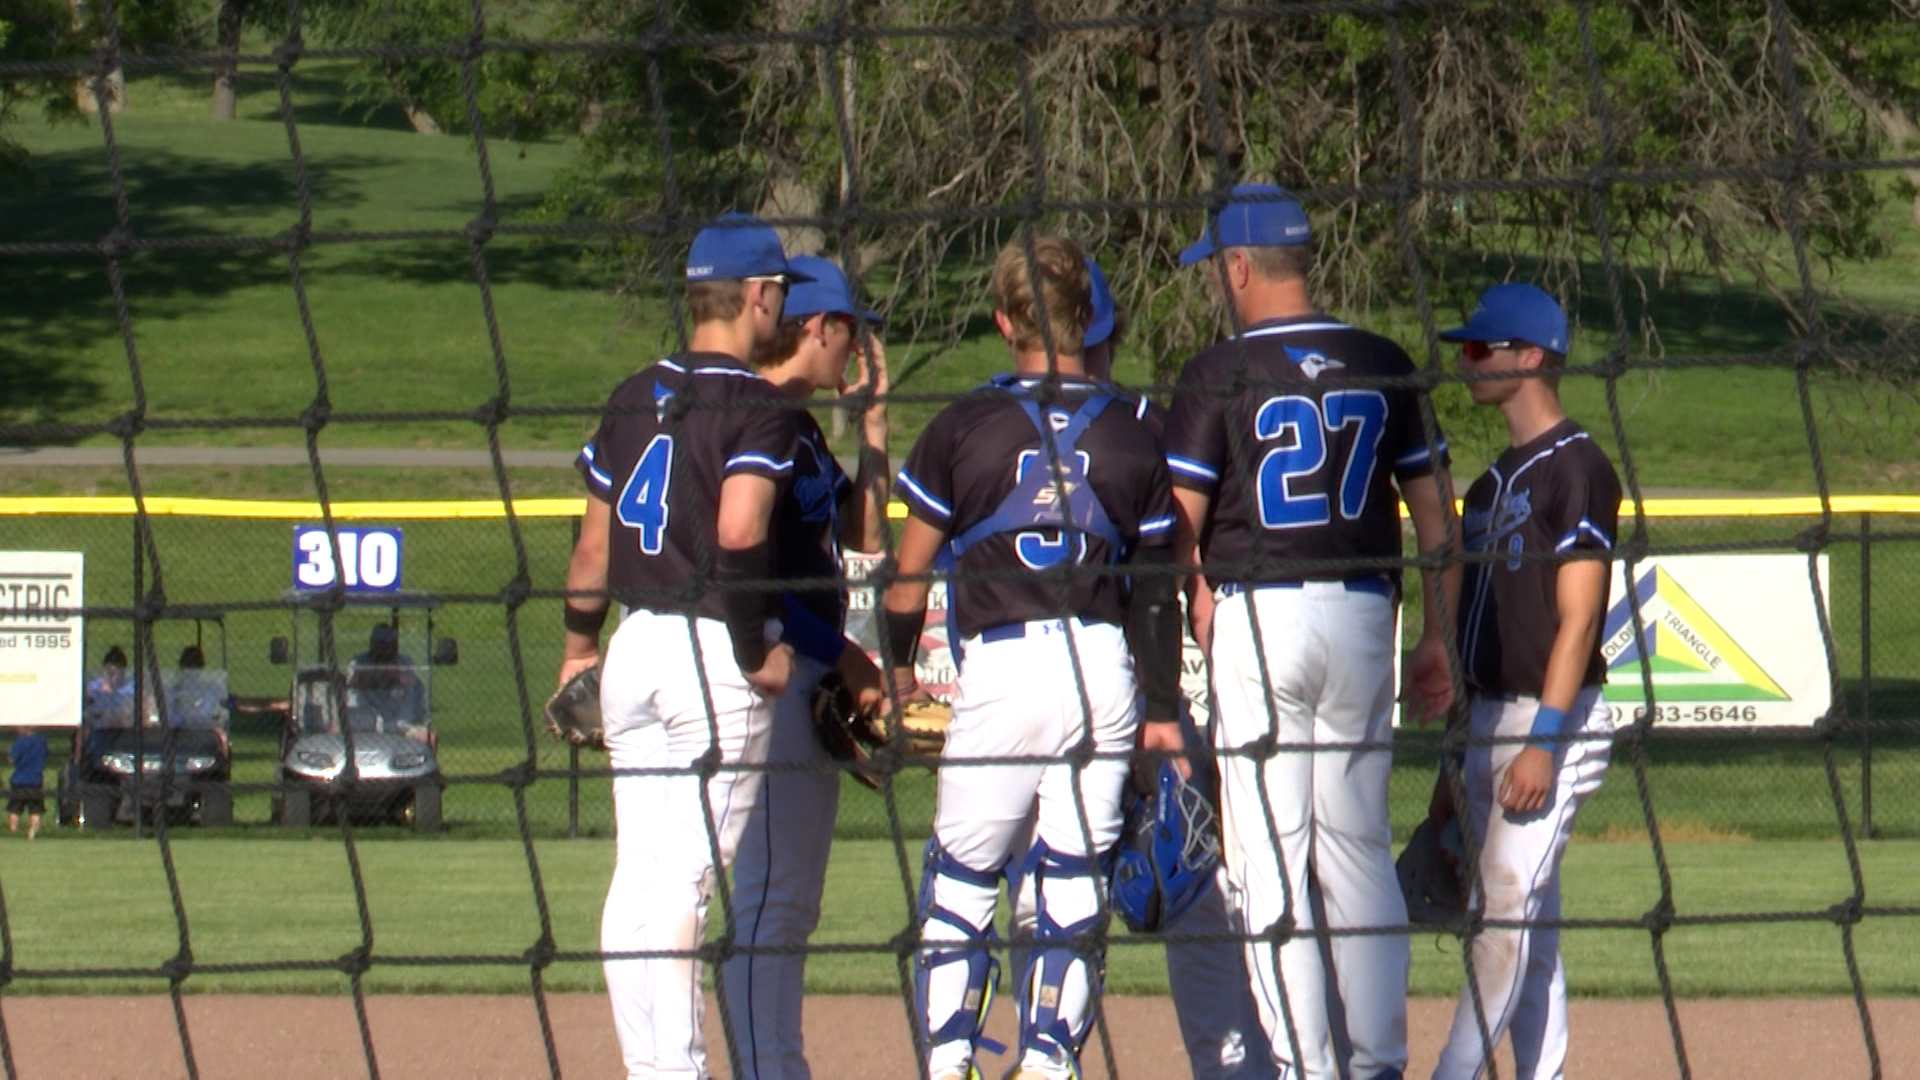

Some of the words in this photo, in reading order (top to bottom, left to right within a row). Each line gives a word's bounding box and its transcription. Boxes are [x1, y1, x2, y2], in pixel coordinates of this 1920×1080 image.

[1256, 390, 1389, 529] 27
[616, 434, 673, 555] 4
[298, 531, 397, 587] 310
[23, 635, 72, 649] 1995
[1663, 609, 1723, 671] TRIANGLE
